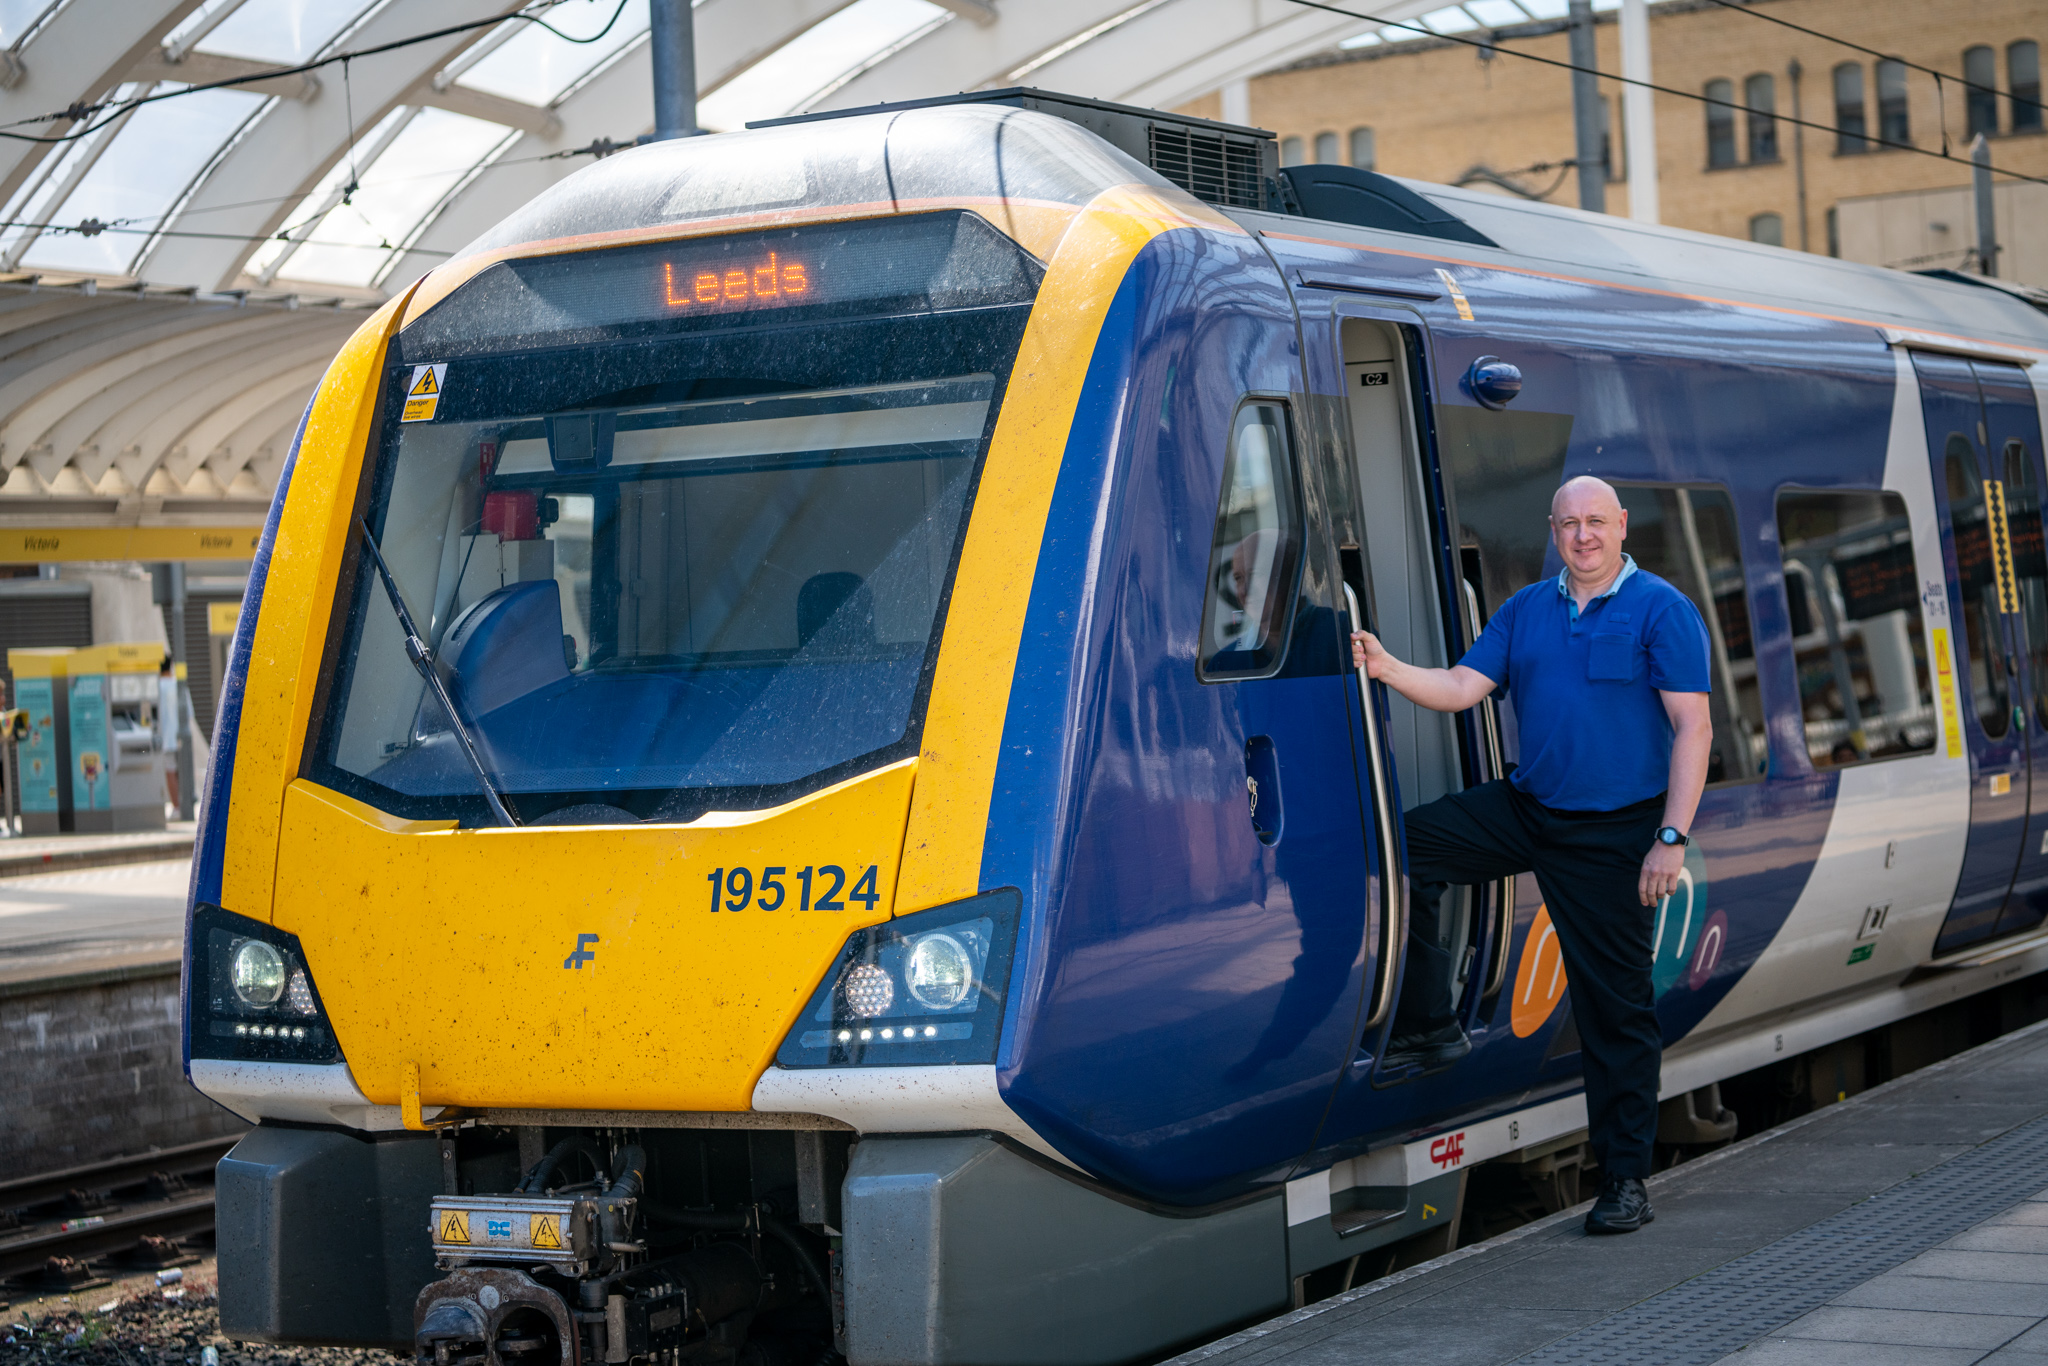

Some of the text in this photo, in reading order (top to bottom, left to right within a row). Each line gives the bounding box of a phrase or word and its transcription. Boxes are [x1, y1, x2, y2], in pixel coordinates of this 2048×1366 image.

[665, 251, 806, 305] Leeds
[1365, 373, 1383, 386] C2
[407, 399, 429, 407] Danger
[24, 535, 60, 551] Victoria
[201, 535, 233, 550] Victoria
[706, 864, 881, 913] 195124
[1429, 1131, 1466, 1170] CAF
